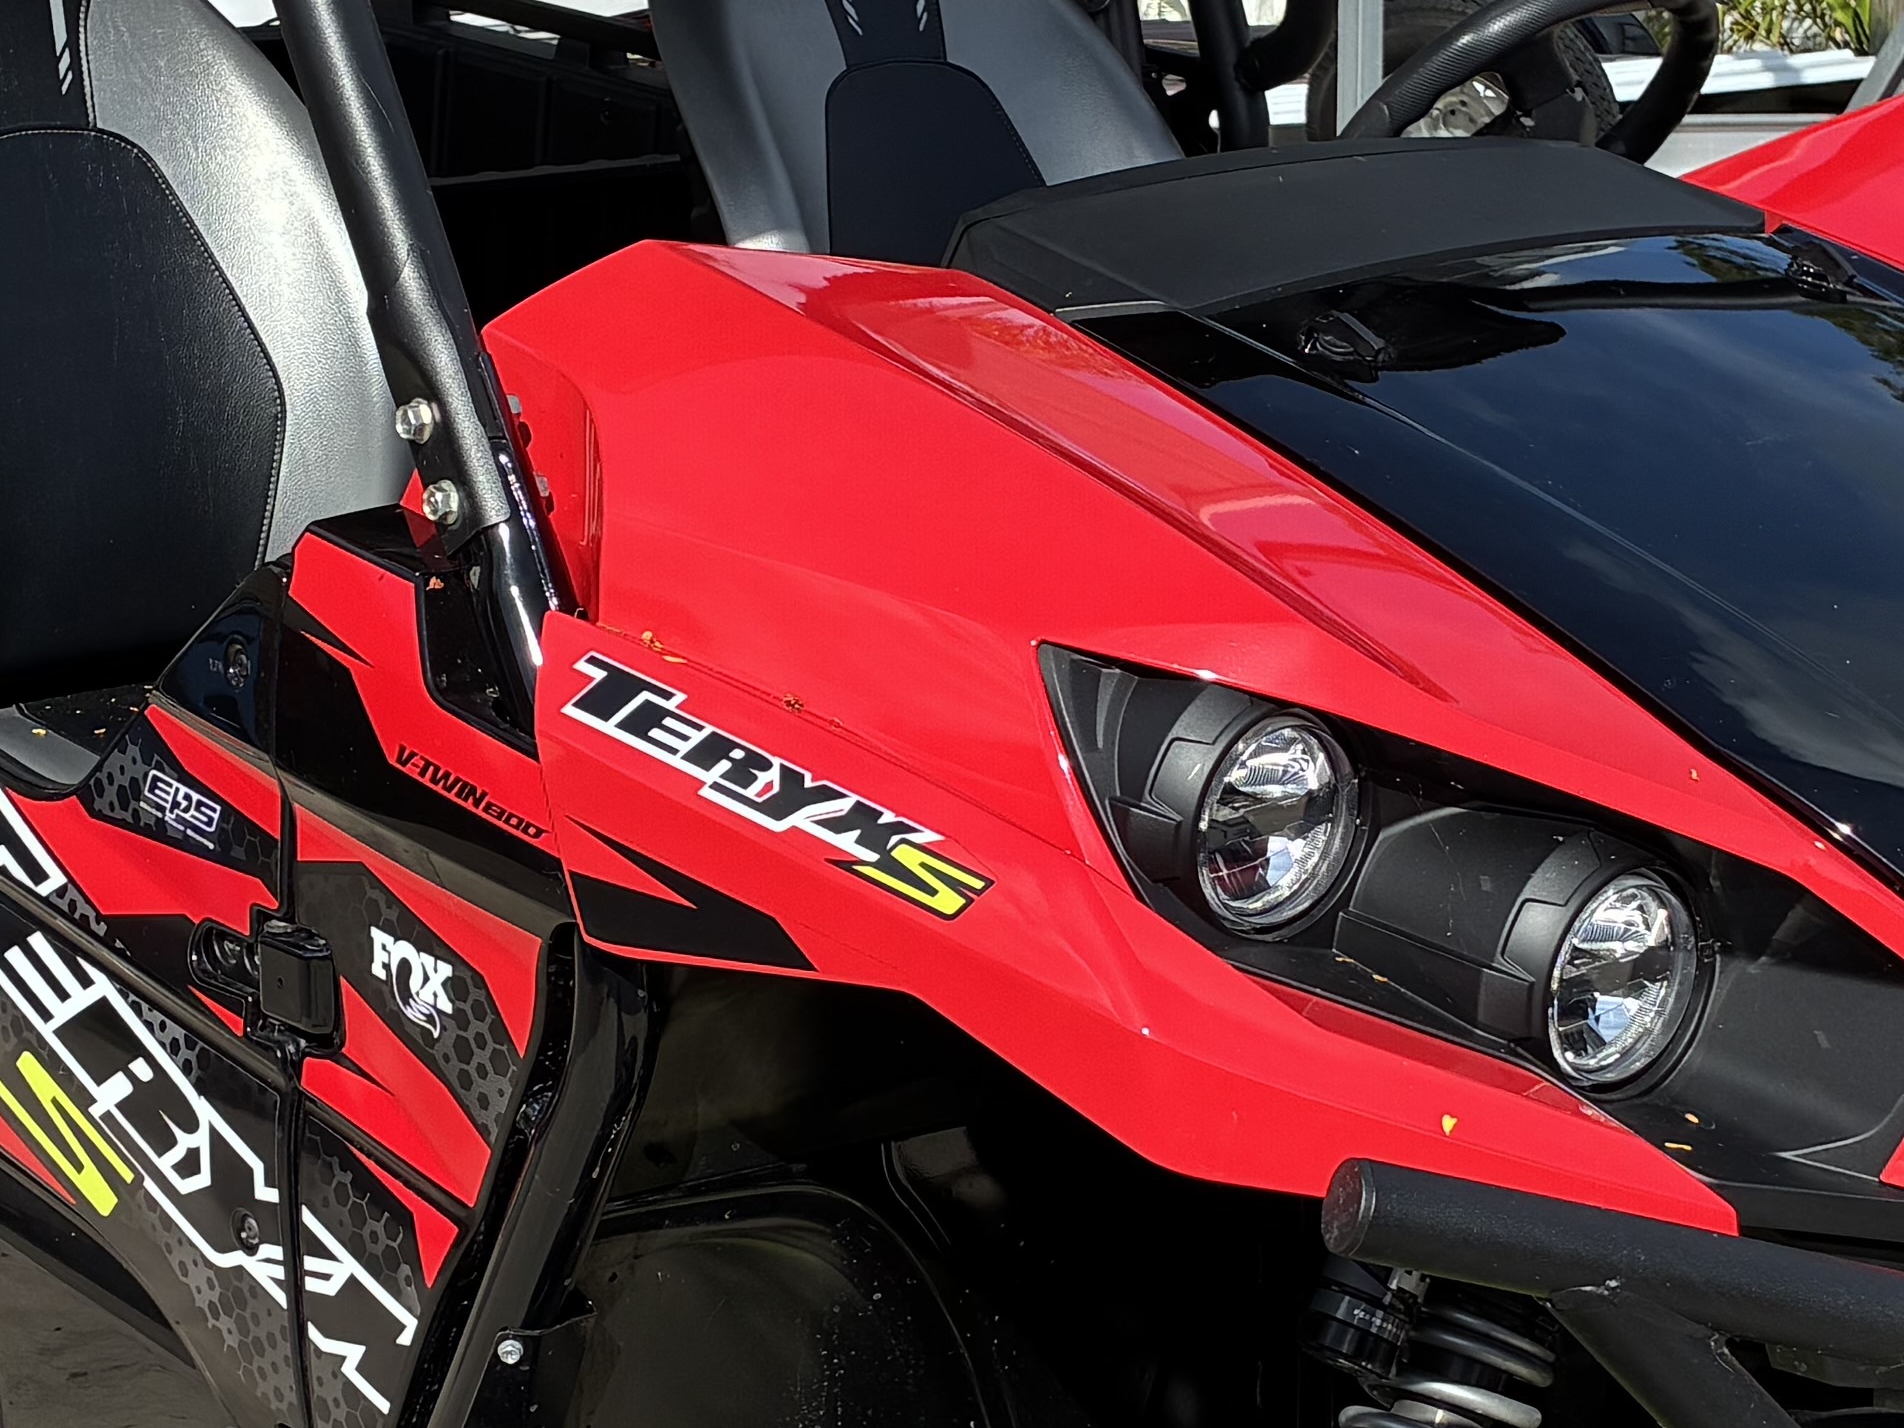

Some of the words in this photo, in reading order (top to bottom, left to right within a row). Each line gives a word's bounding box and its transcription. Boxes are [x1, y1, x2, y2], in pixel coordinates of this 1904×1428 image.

[144, 769, 222, 833] EPS
[395, 743, 489, 810] V-TWIN
[561, 651, 946, 863] TERYX
[370, 925, 454, 1039] FOX
